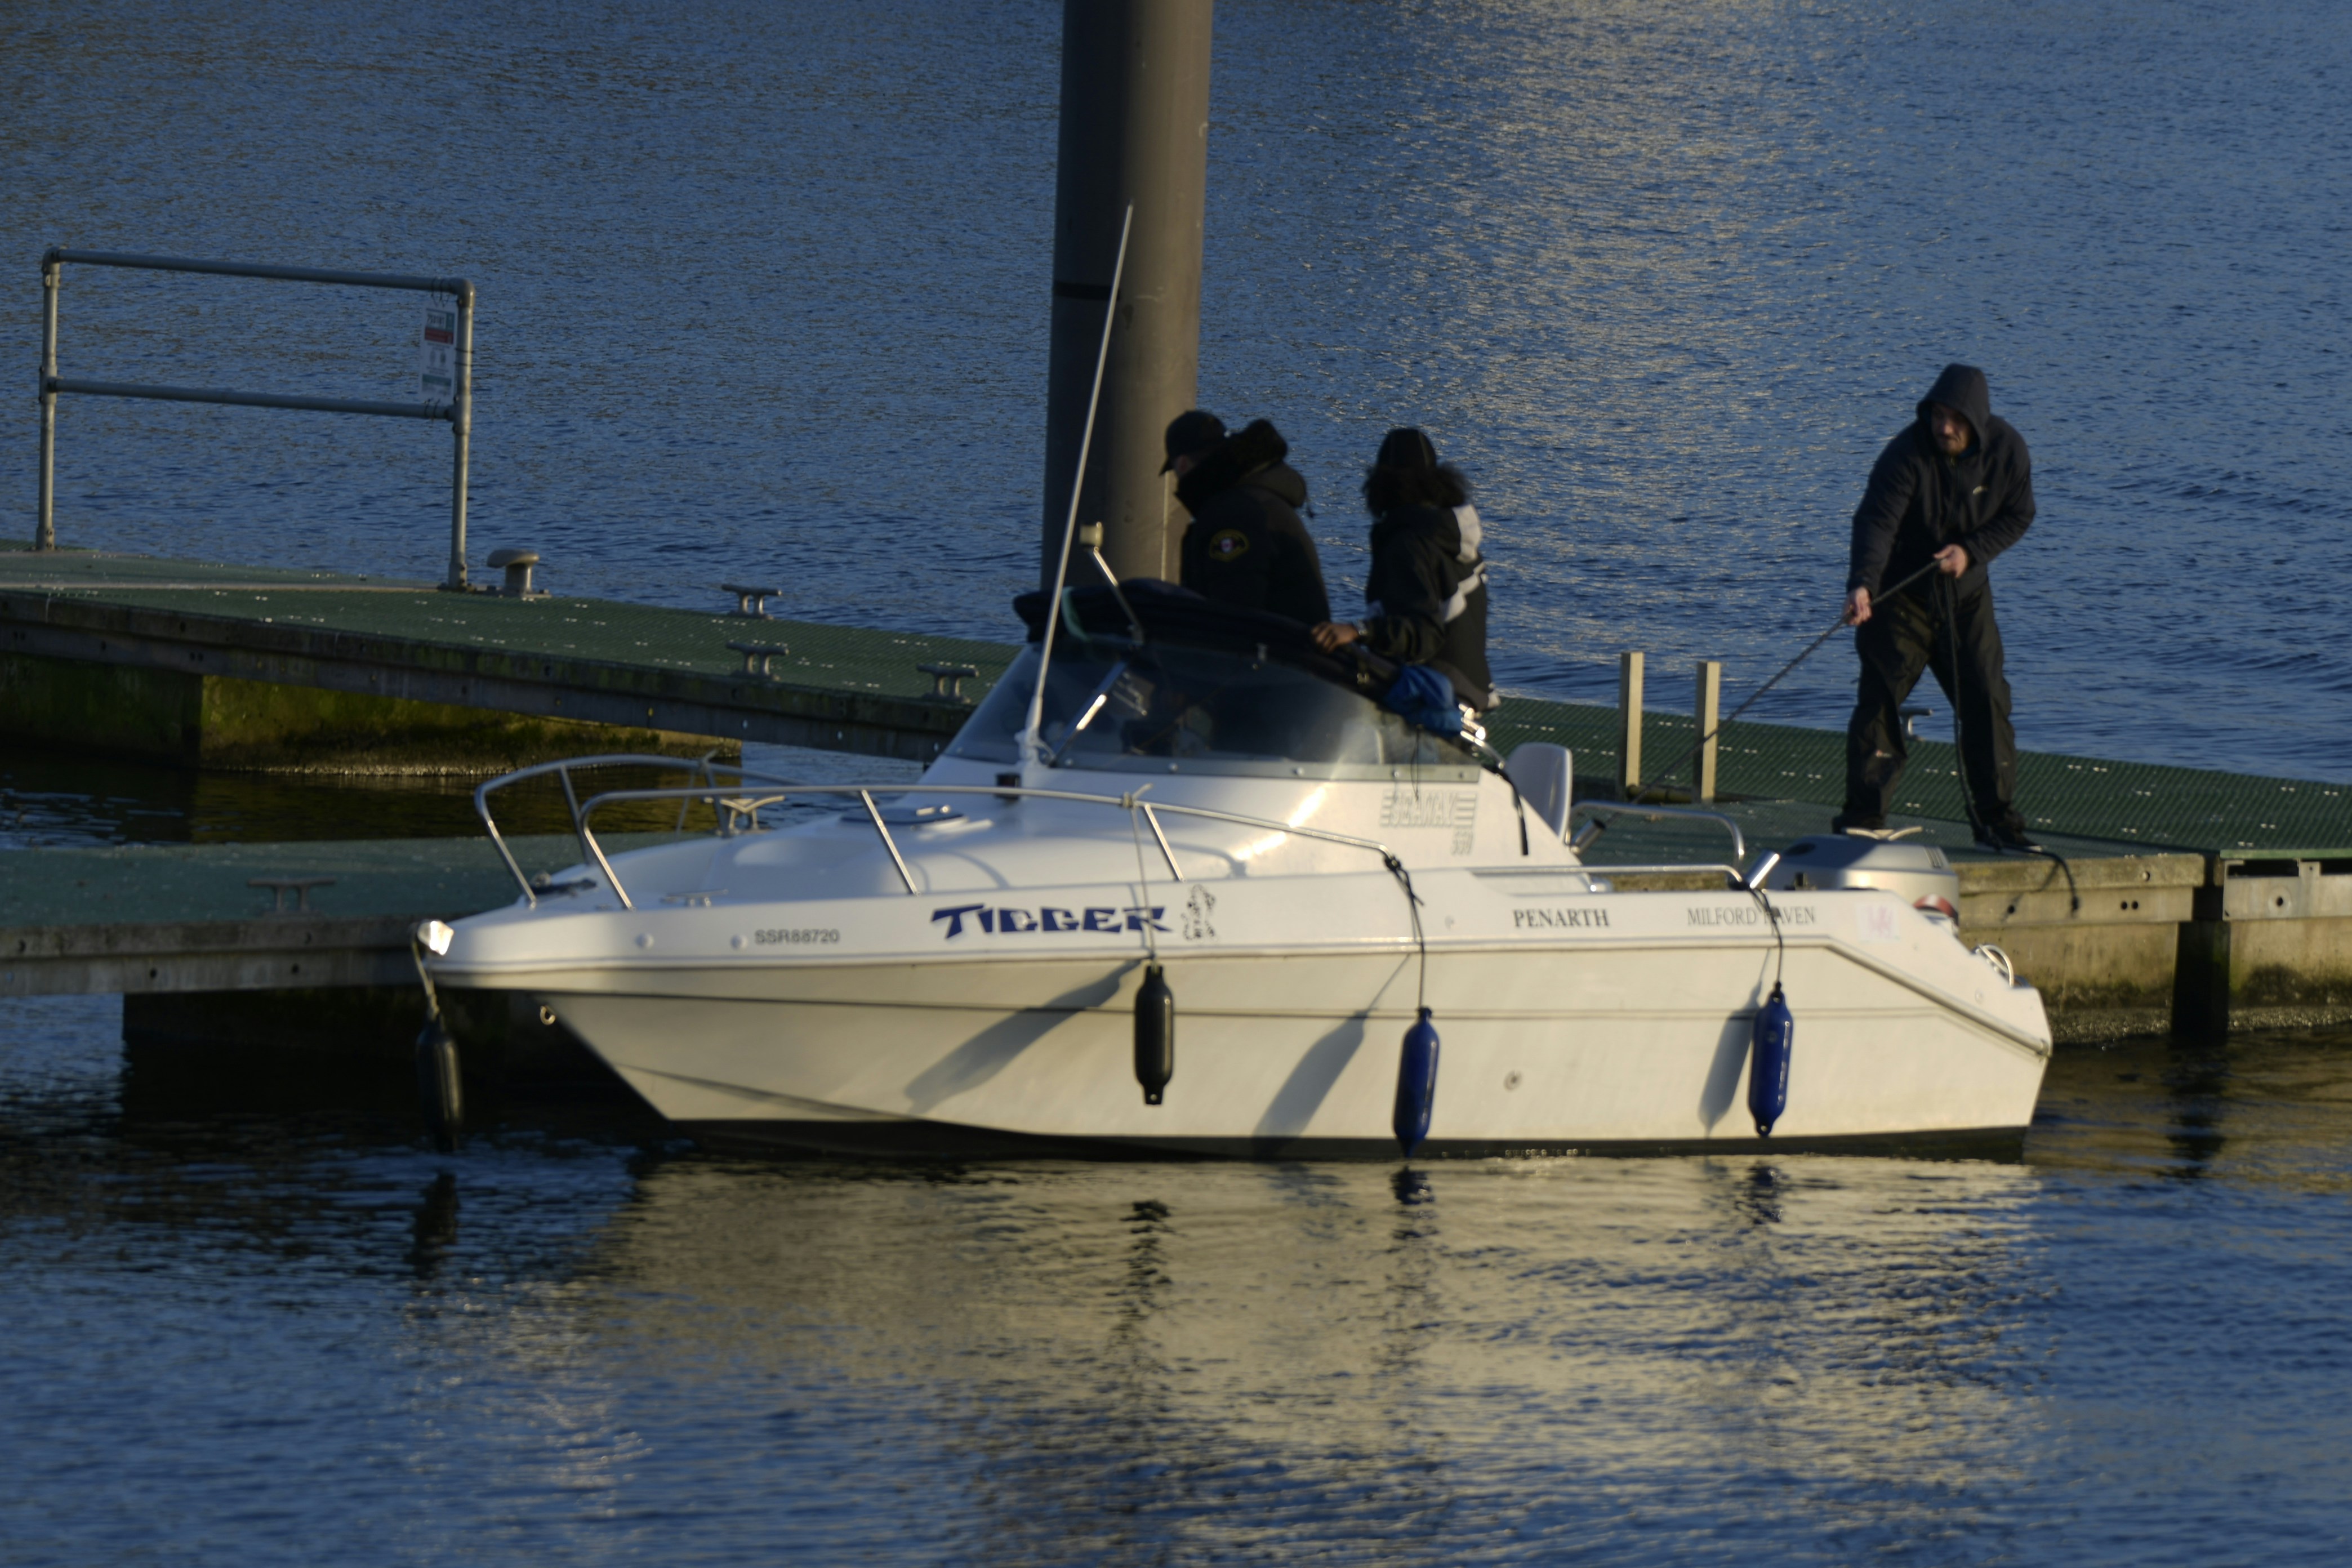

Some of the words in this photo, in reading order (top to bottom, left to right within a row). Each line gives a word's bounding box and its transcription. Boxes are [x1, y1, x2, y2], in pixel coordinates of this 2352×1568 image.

[1389, 790, 1458, 828] SEAWAY
[931, 903, 1173, 939] TIGGER
[1512, 907, 1610, 928] PENARTH
[1687, 907, 1757, 926] MILFORD
